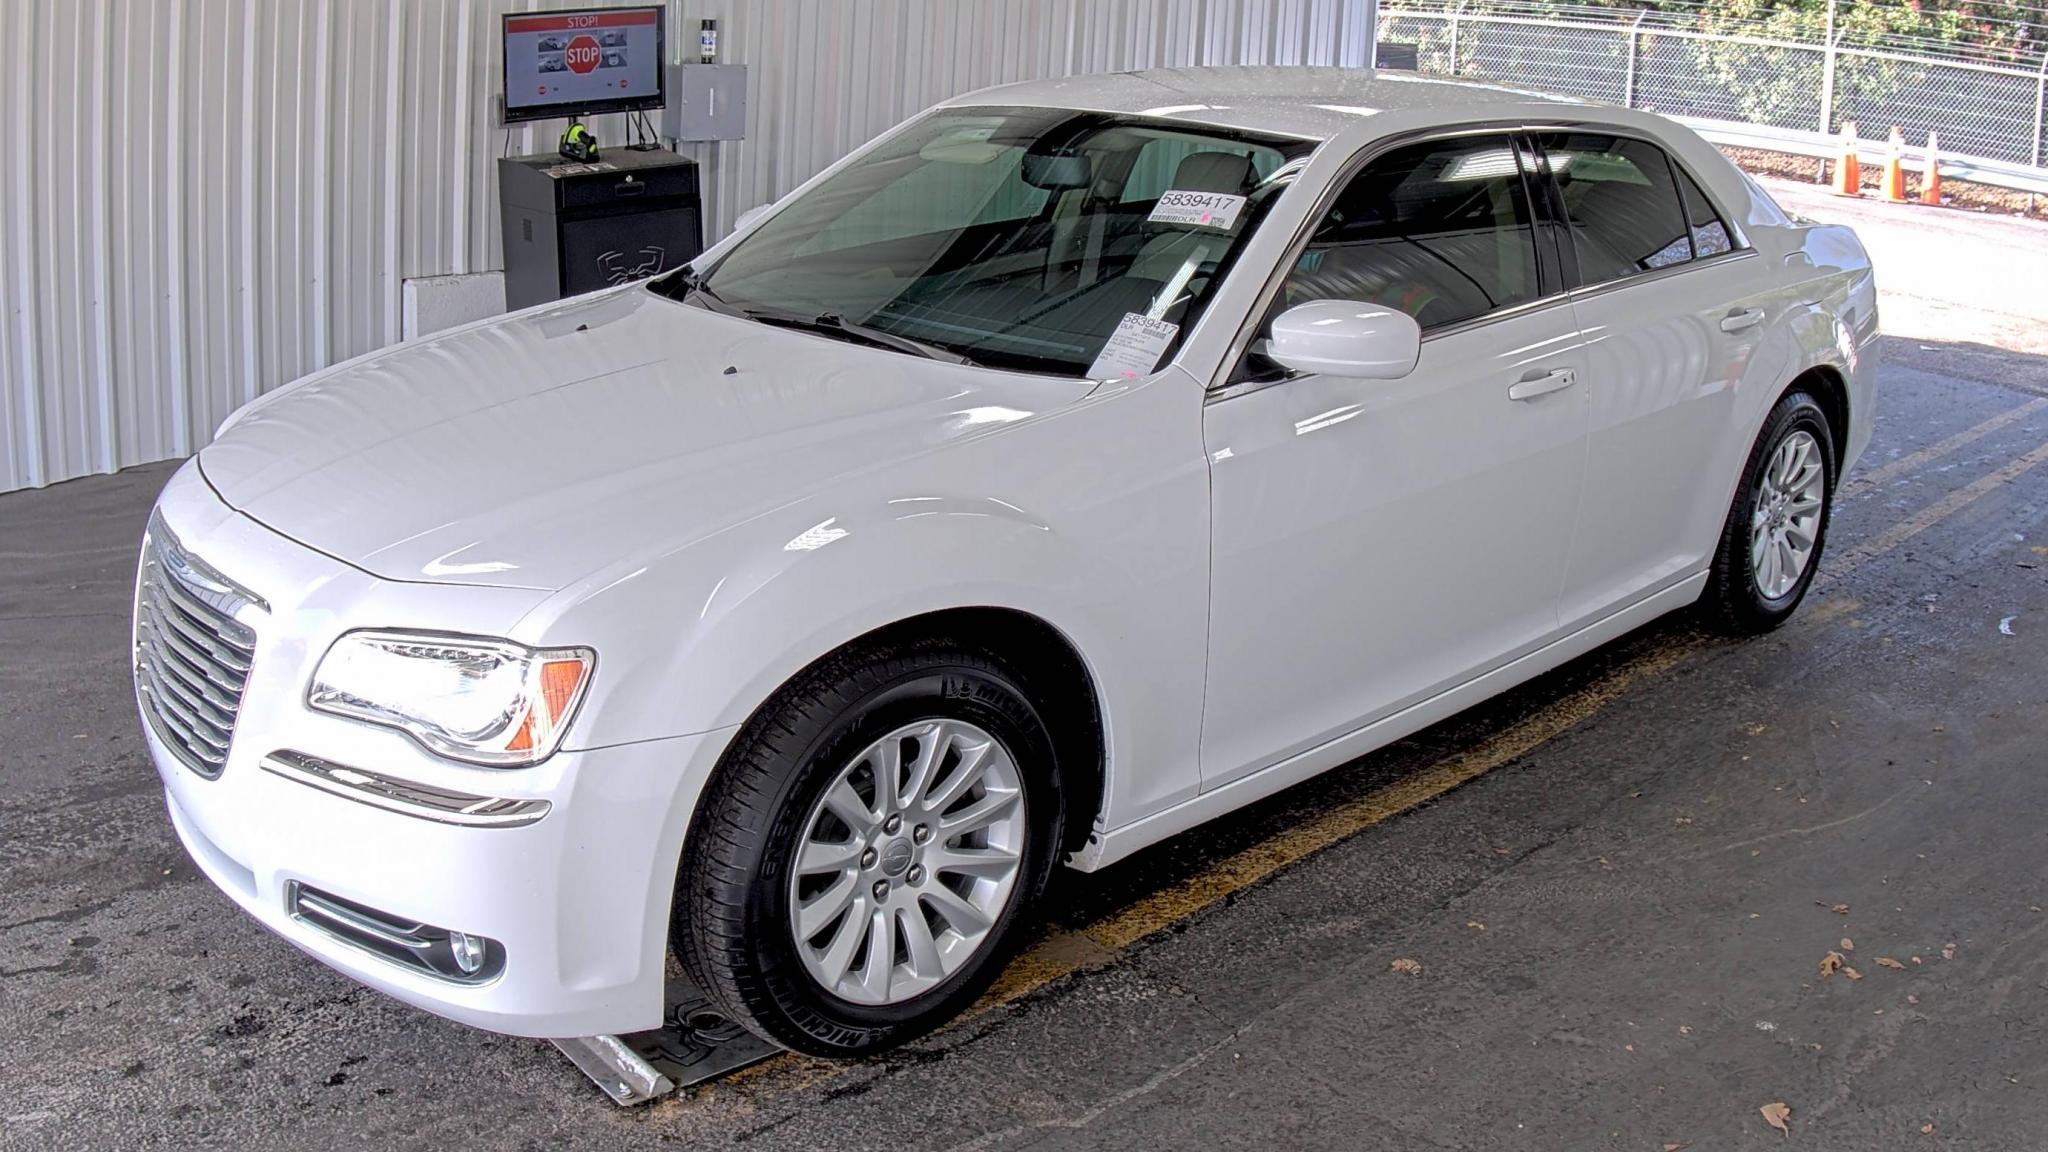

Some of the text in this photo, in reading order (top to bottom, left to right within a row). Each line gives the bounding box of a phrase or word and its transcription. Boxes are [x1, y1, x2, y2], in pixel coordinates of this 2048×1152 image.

[567, 16, 598, 28] STOP!
[568, 47, 598, 63] STOP
[1160, 193, 1236, 210] 5839417
[1123, 313, 1178, 335] 5839417
